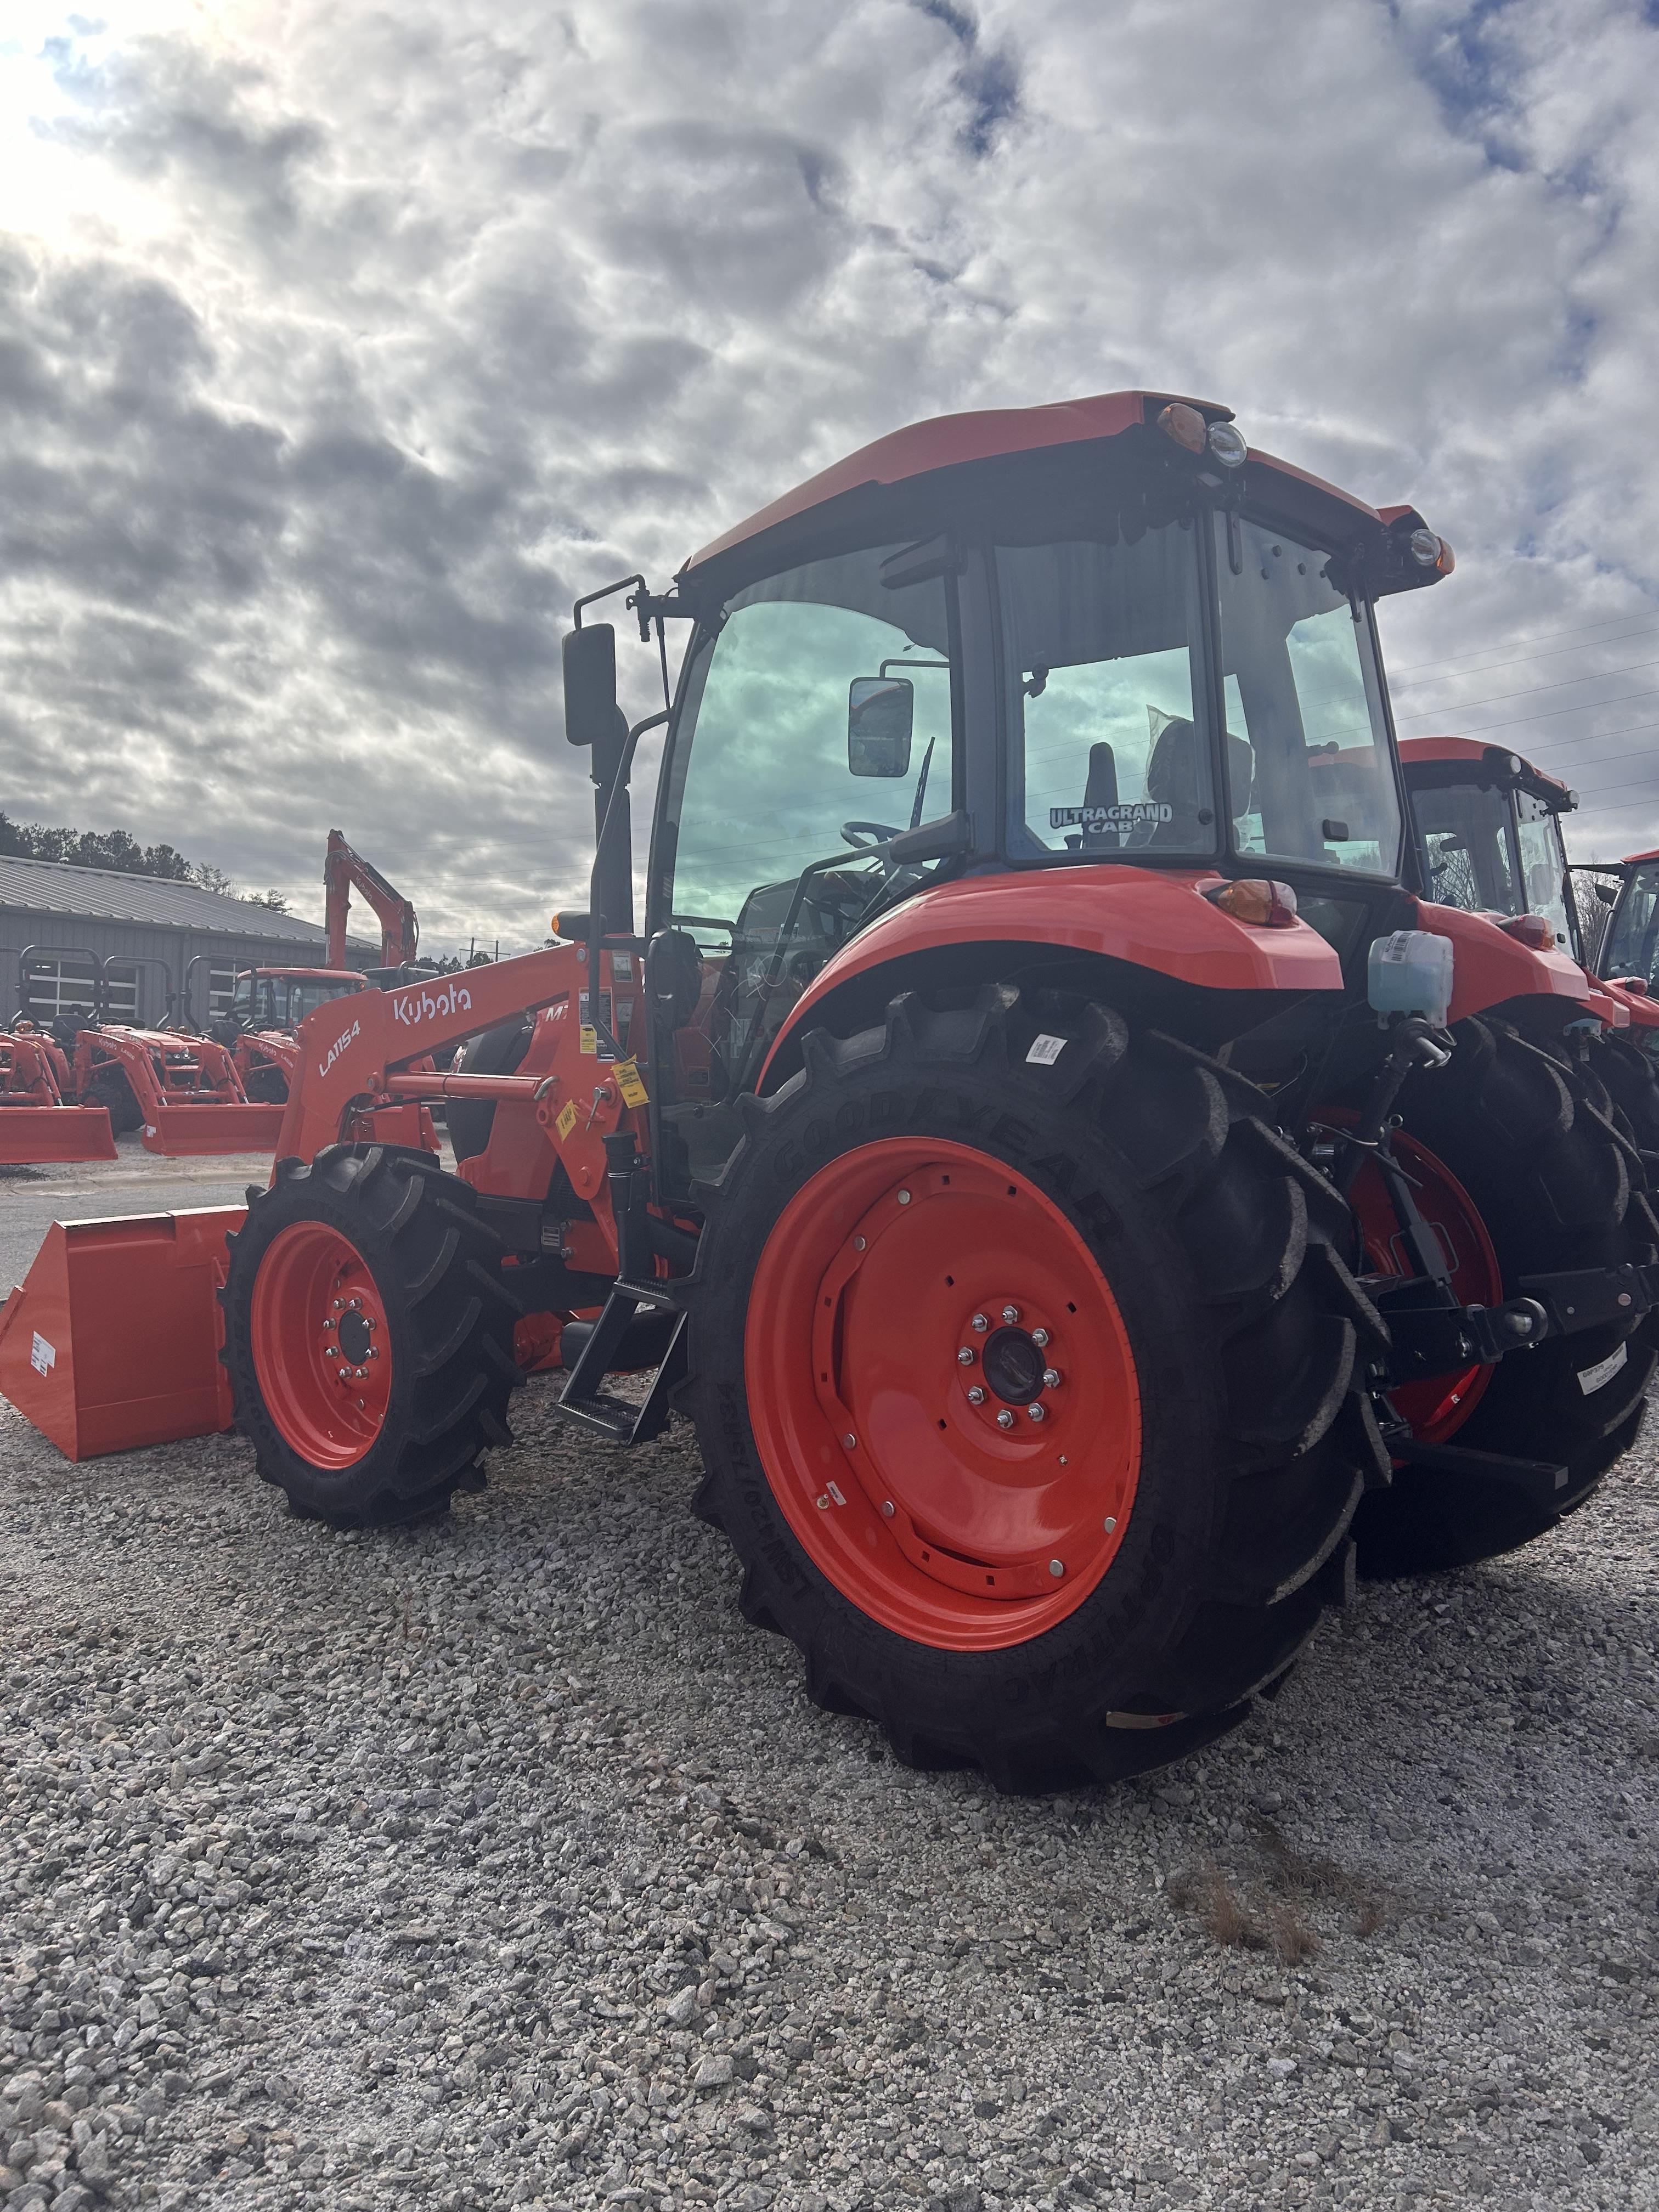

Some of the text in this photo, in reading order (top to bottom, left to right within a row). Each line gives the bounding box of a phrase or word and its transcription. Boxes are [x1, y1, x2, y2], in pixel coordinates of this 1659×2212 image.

[1051, 803, 1172, 828] ULTRAGRAND
[1088, 821, 1133, 833] CAB
[356, 875, 373, 901] Kubota
[393, 983, 472, 1025] Kubota
[98, 1037, 117, 1051] Kubota
[258, 1042, 277, 1056] Kubota
[318, 1019, 361, 1077] LA1154
[772, 1088, 1124, 1243] GOODYEAR
[1001, 1521, 1176, 1704] OPTITRAC
